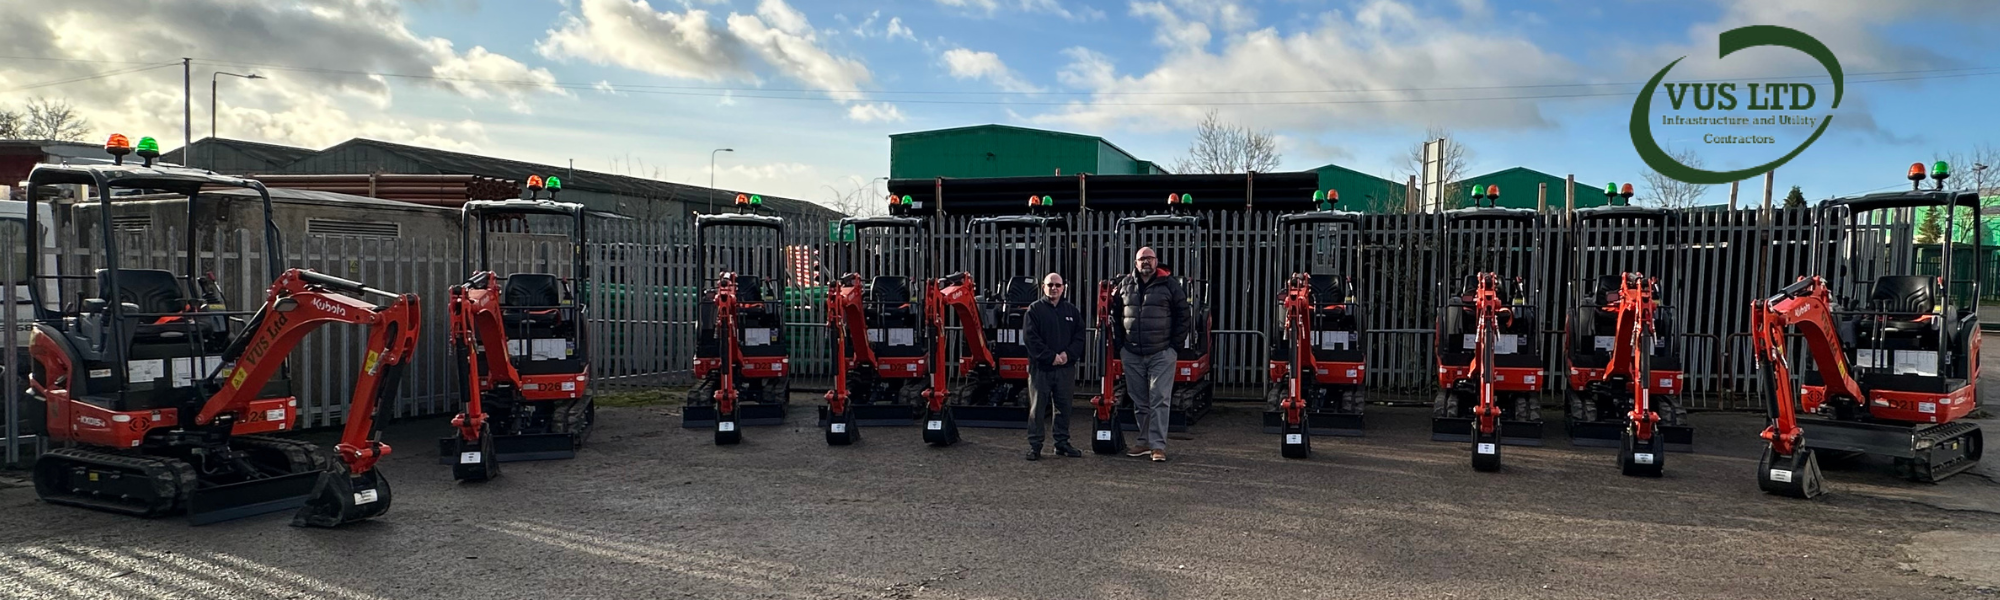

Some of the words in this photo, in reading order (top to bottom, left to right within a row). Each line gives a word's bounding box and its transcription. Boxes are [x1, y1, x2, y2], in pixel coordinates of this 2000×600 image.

[312, 297, 346, 316] Kubota
[246, 336, 270, 365] VUS
[266, 312, 289, 339] Ltd
[538, 382, 561, 392] D26
[1889, 399, 1915, 411] D21
[240, 410, 267, 423] 24
